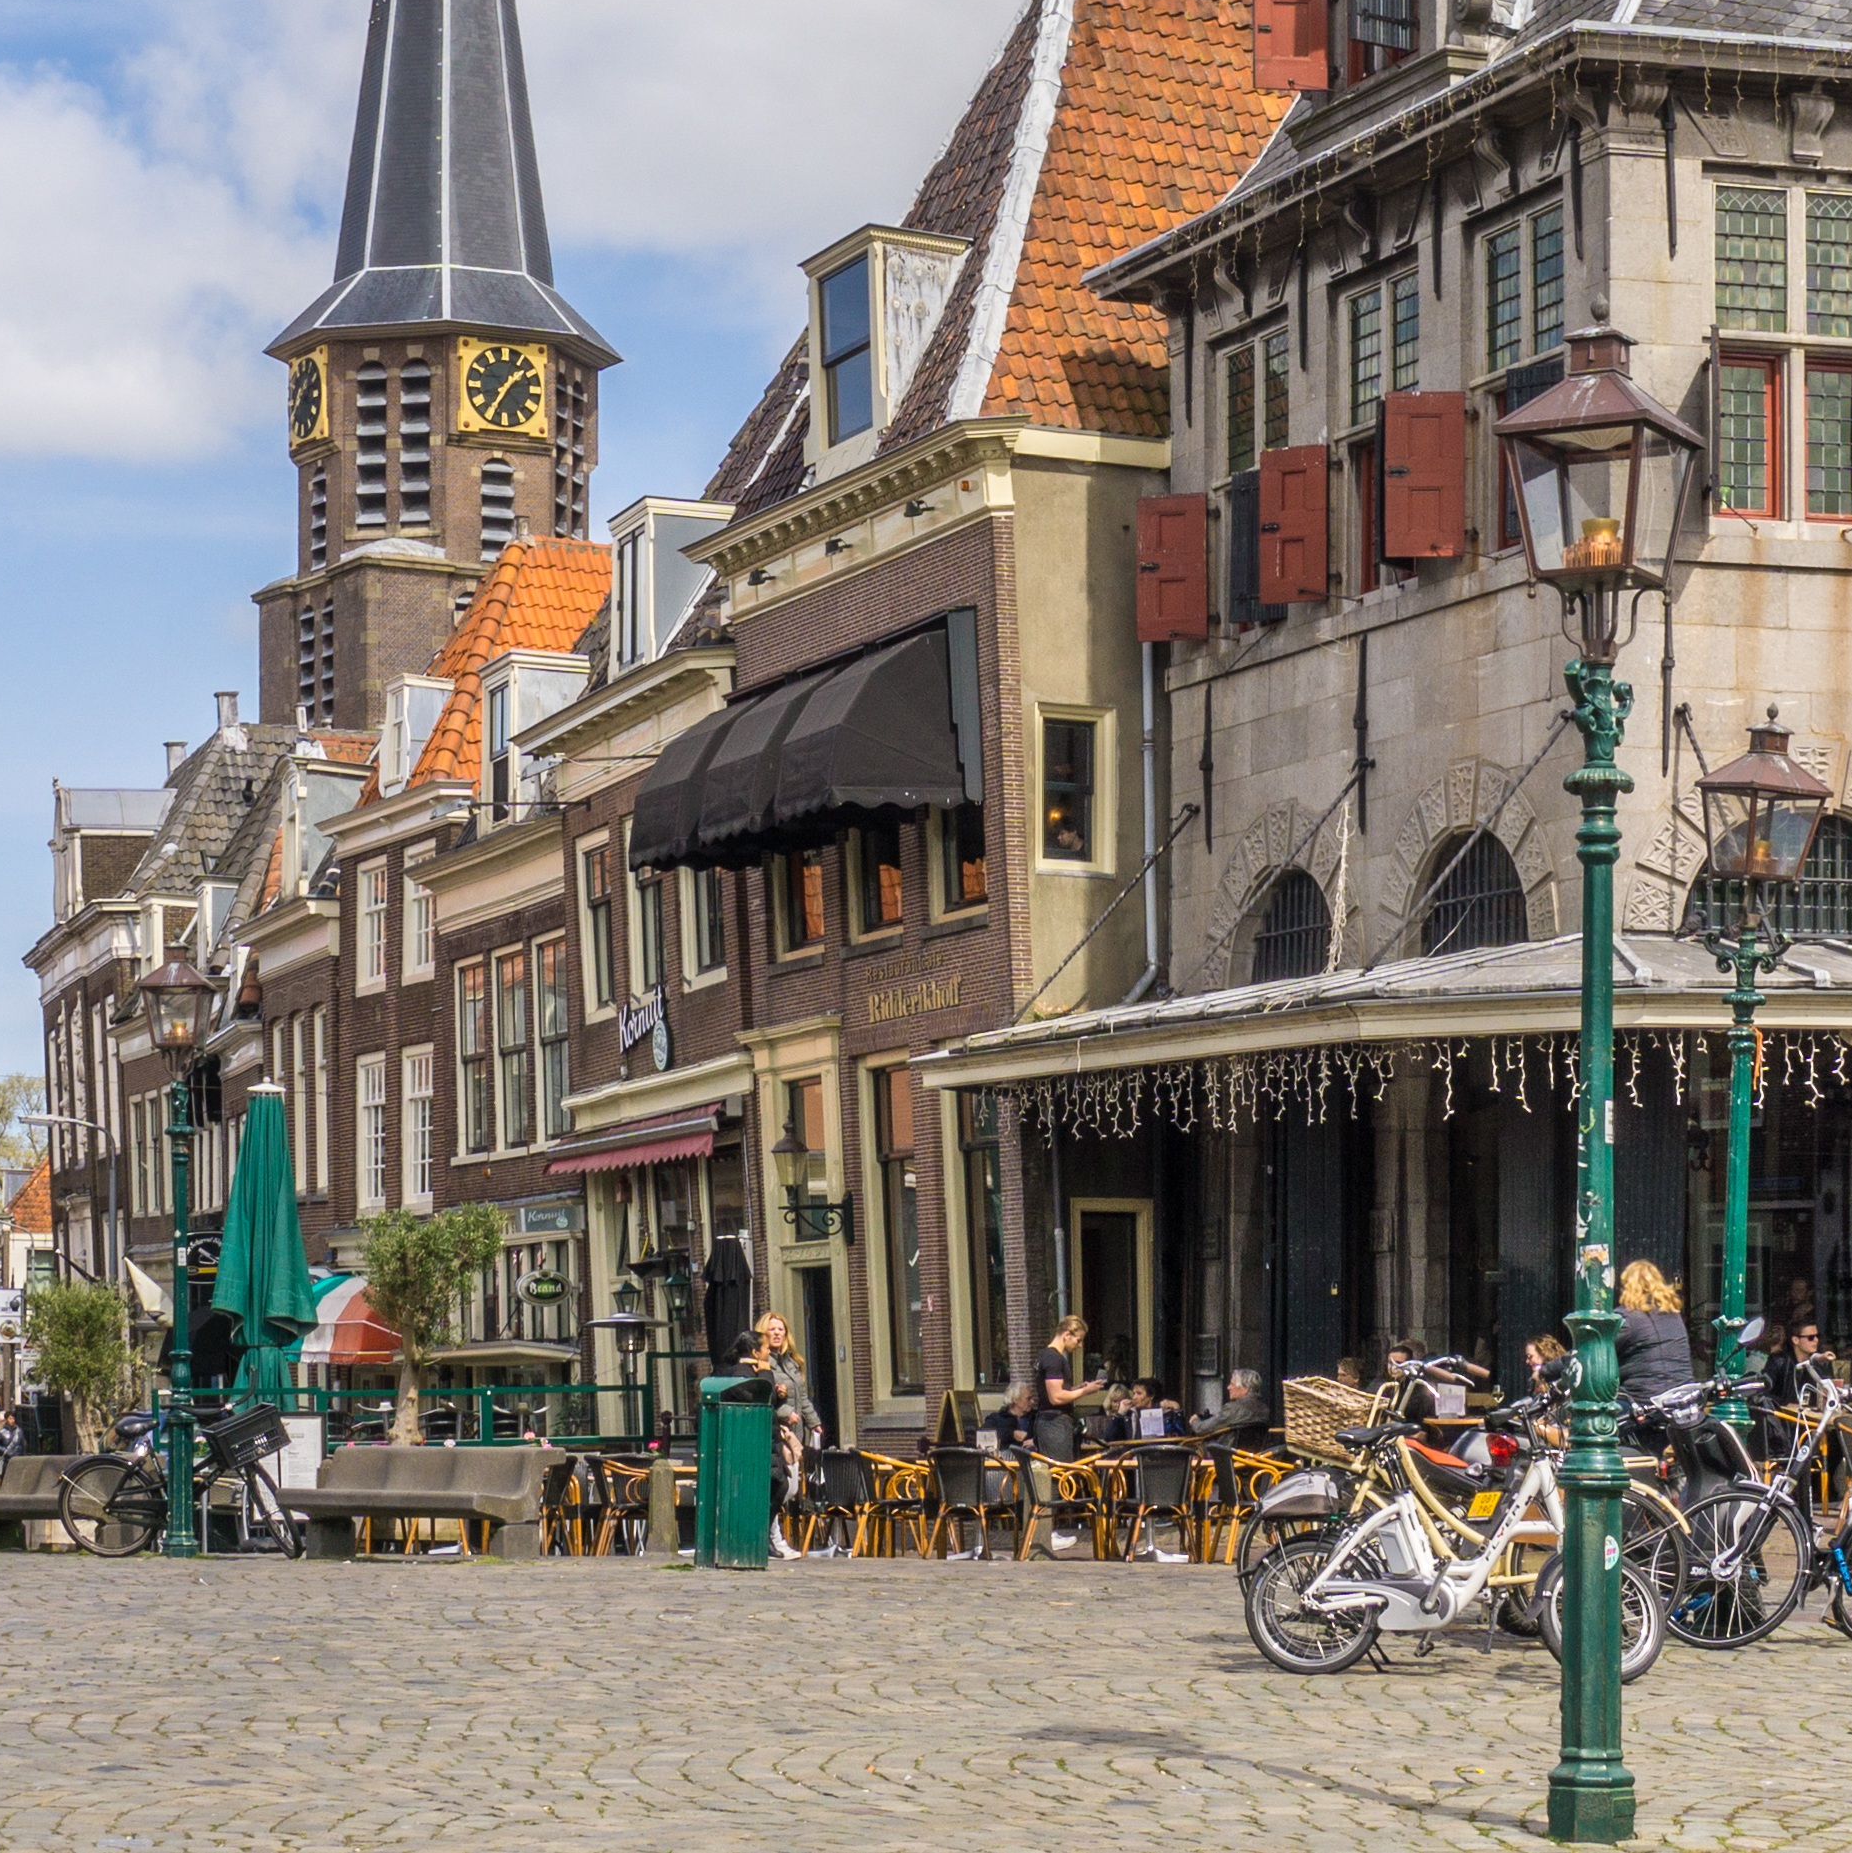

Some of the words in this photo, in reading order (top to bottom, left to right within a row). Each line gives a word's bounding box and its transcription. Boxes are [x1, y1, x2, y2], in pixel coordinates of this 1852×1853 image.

[619, 984, 664, 1054] Kornuit
[869, 975, 962, 1024] Ridderikhoff
[529, 1281, 562, 1294] Brand
[1485, 1503, 1521, 1562] FLYER
